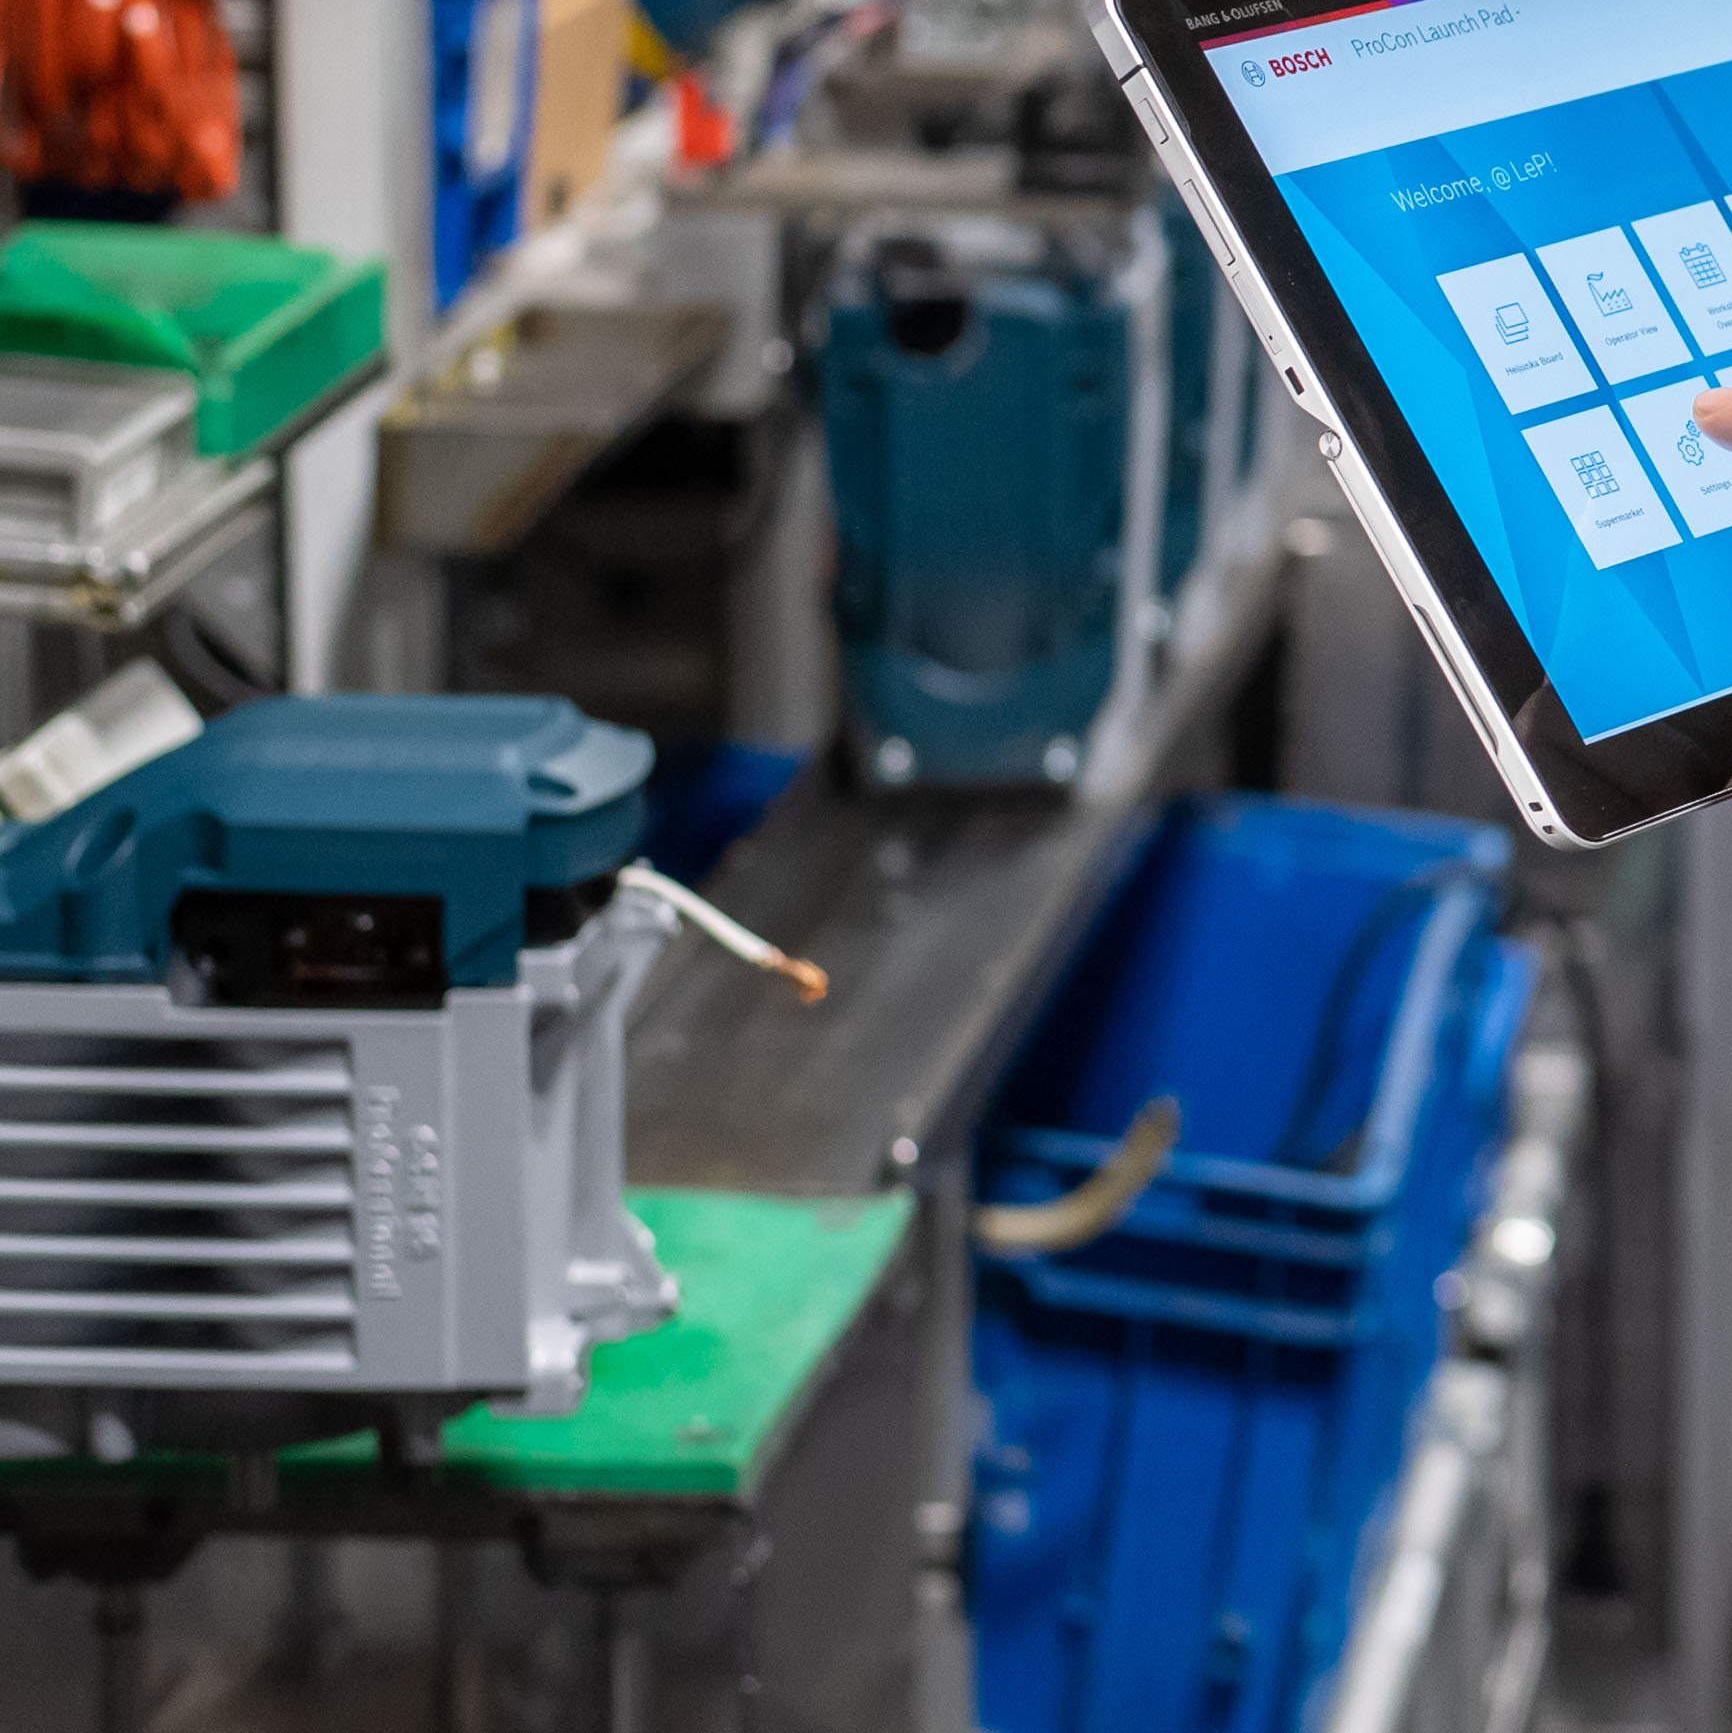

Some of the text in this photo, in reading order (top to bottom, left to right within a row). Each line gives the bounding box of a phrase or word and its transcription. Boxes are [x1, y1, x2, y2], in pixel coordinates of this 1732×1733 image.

[1185, 12, 1220, 30] BANG
[1230, 0, 1284, 21] OLUFSEN
[1350, 32, 1419, 58] ProCon
[1416, 13, 1481, 44] Launch
[1478, 4, 1515, 28] Pad
[1269, 48, 1333, 78] BOSCH
[1390, 152, 1558, 212] Welcome, @ LeP!
[1605, 325, 1659, 347] Operator View
[1539, 351, 1565, 367] Board
[1700, 479, 1732, 496] Settings
[1595, 507, 1645, 530] Supermarket
